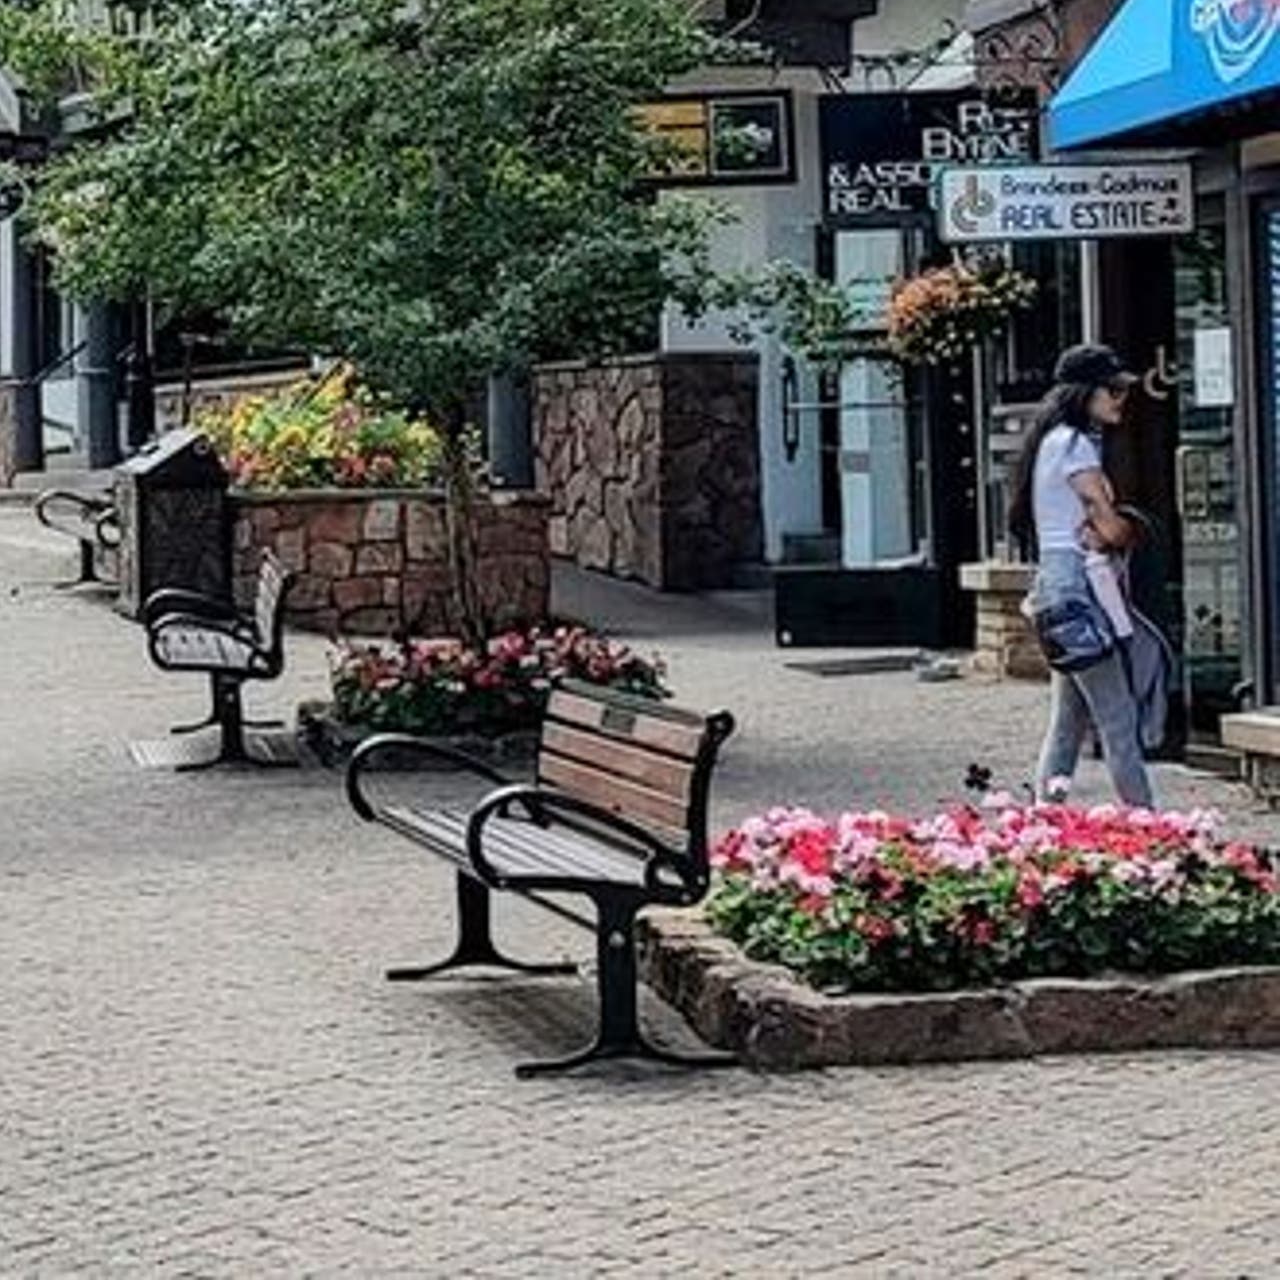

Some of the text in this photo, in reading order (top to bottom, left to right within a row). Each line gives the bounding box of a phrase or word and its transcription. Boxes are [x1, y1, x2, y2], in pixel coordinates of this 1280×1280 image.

[829, 188, 912, 213] REAL
[1001, 205, 1064, 231] REAL
[1070, 201, 1158, 229] ESTATE
